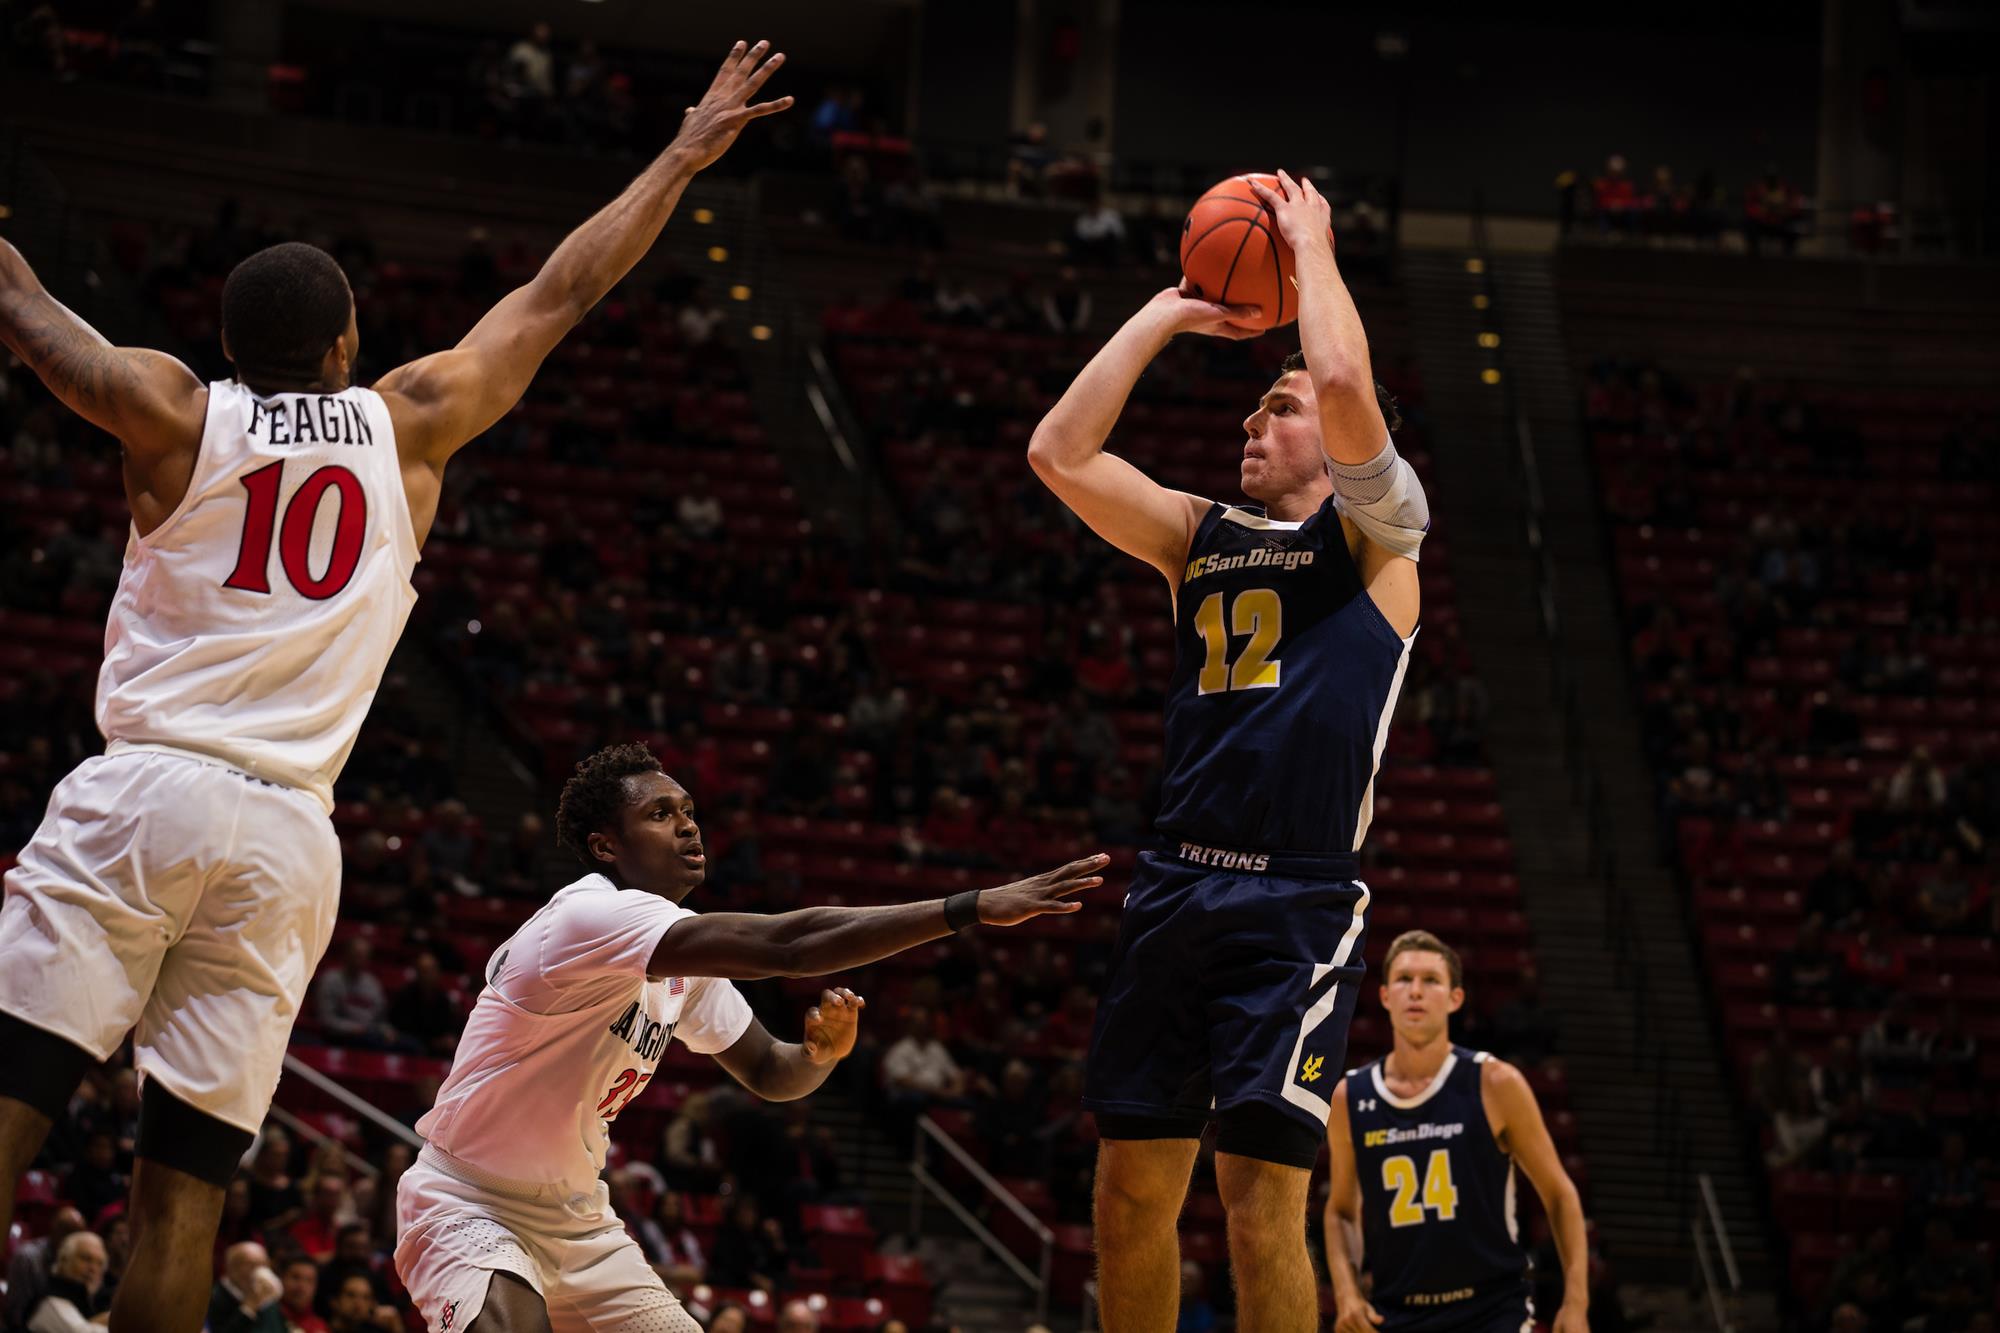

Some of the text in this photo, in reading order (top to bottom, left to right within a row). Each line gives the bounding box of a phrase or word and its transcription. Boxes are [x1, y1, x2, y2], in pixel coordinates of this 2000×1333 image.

[248, 396, 373, 446] FEAGIN
[222, 458, 367, 600] 10
[1194, 588, 1282, 696] 12
[1179, 842, 1270, 871] TRITONS
[1382, 1149, 1458, 1228] 24
